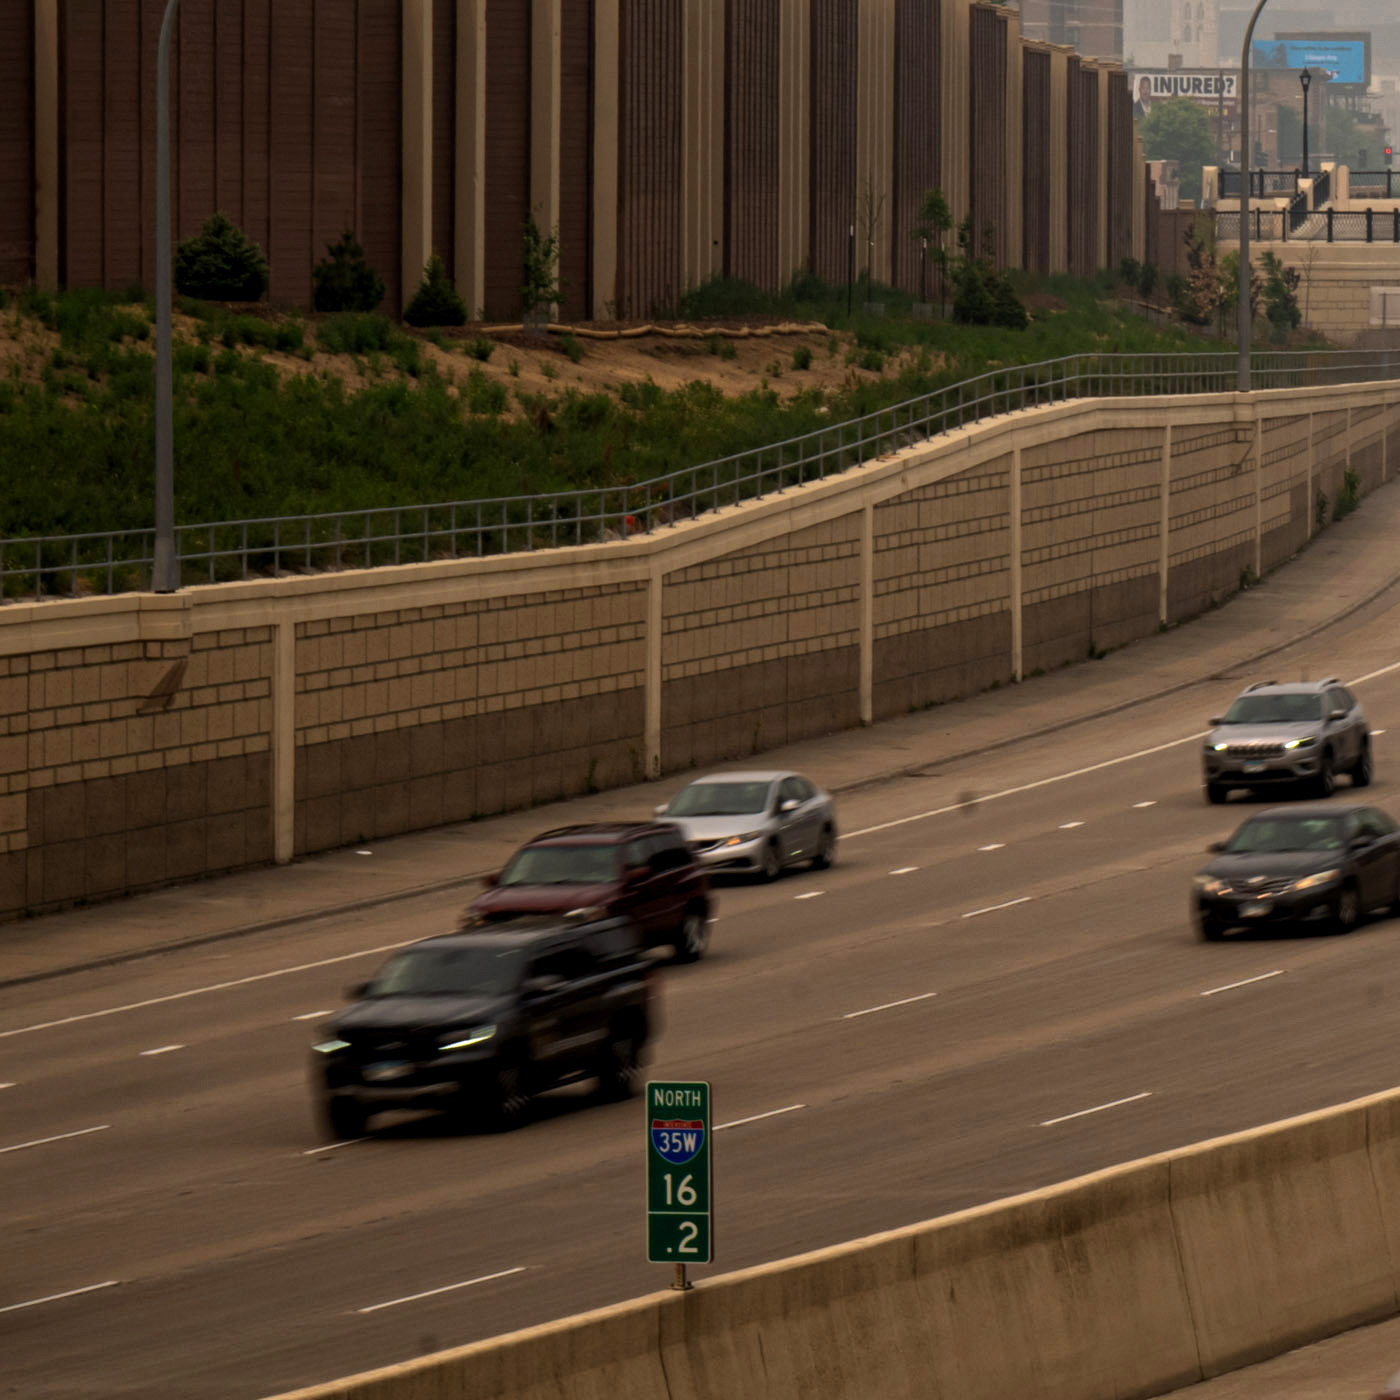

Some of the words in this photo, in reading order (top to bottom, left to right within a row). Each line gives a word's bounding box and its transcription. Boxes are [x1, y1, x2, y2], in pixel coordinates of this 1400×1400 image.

[1153, 77, 1234, 96] INJURED?
[654, 1088, 701, 1107] NORTH
[659, 1132, 697, 1153] 35W
[664, 1173, 697, 1206] 16
[666, 1221, 698, 1253] .2
